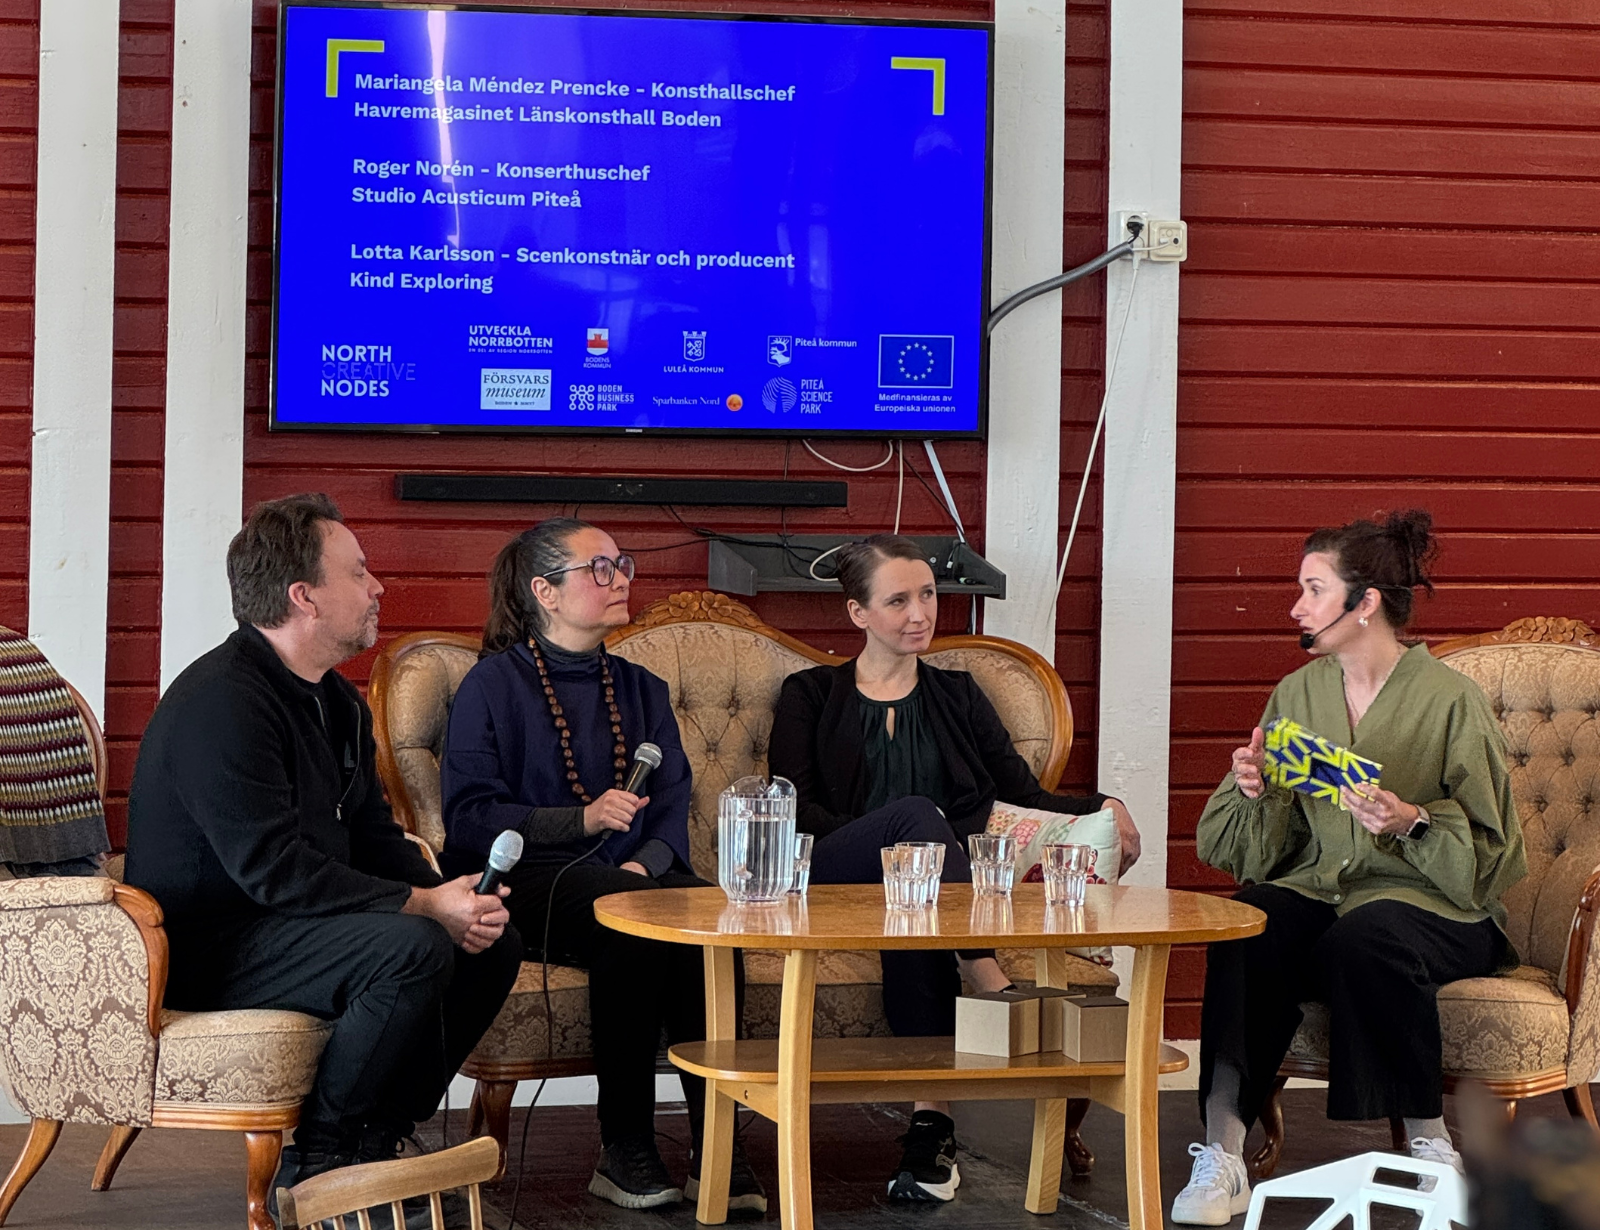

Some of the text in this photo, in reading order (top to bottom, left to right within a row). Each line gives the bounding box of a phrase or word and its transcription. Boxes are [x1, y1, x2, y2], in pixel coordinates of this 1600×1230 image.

[355, 74, 464, 95] Mariangela
[469, 75, 545, 94] Méndez
[550, 79, 629, 96] Prencke
[651, 82, 796, 101] Konsthallschef
[354, 102, 721, 127] Havremagasinet Länskonsthall Boden
[353, 159, 410, 179] Roger
[415, 160, 474, 177] Norén
[496, 162, 650, 181] Konserthuschef
[351, 187, 582, 208] Studio Acusticum Piteå
[351, 243, 403, 260] Lotta
[409, 245, 494, 262] Karlsson
[516, 247, 651, 265] Scenkonstnär
[656, 250, 690, 266] och
[696, 252, 795, 270] producent
[350, 271, 493, 294] Kind Exploring
[469, 325, 532, 336] UTVECKLA
[469, 336, 553, 347] NORRBOTTEN
[795, 337, 857, 347] Piteå kommun
[322, 344, 392, 362] NORTH
[321, 362, 416, 380] CREATIVE
[663, 365, 687, 373] LULEÅ
[483, 372, 549, 384] FÖRSVARS
[321, 379, 390, 397] NODES
[597, 385, 622, 393] BODEN
[801, 378, 824, 390] PITEÅ
[486, 387, 546, 398] museum
[597, 394, 635, 402] BUSINESS
[800, 392, 833, 402] SCIENCE
[879, 393, 940, 402] Medfinansieras
[652, 396, 720, 406] Sparbanken Nord
[597, 403, 617, 411] PARK
[800, 403, 821, 414] PARK
[874, 404, 956, 413] Europeiska unionen
